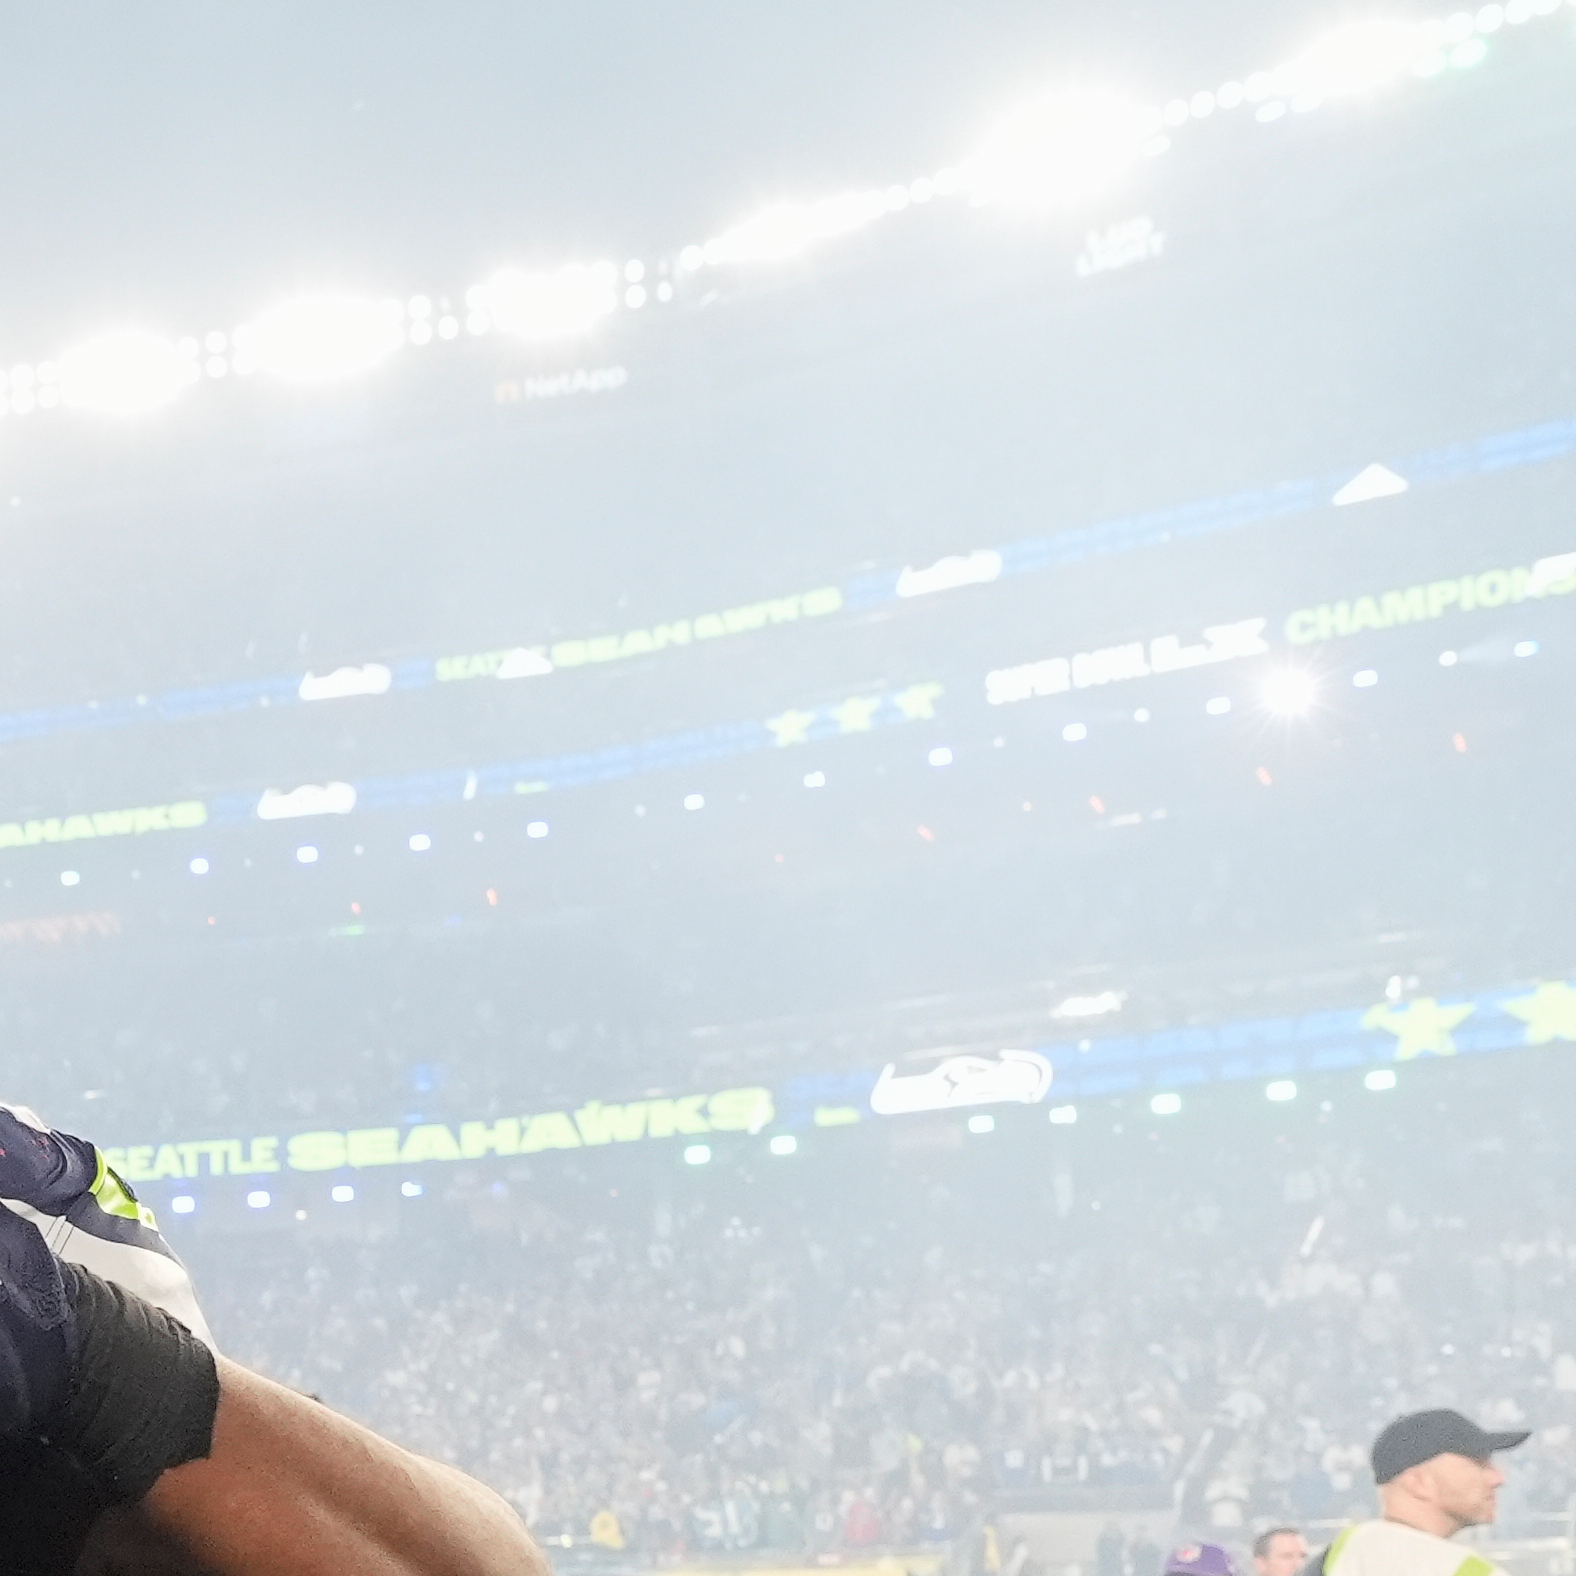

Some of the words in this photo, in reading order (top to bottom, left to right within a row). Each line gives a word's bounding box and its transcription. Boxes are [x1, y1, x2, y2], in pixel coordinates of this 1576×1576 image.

[435, 645, 550, 681] SEAT
[106, 1136, 279, 1184] SEATTLE
[286, 1086, 775, 1173] SEAHAWKS
